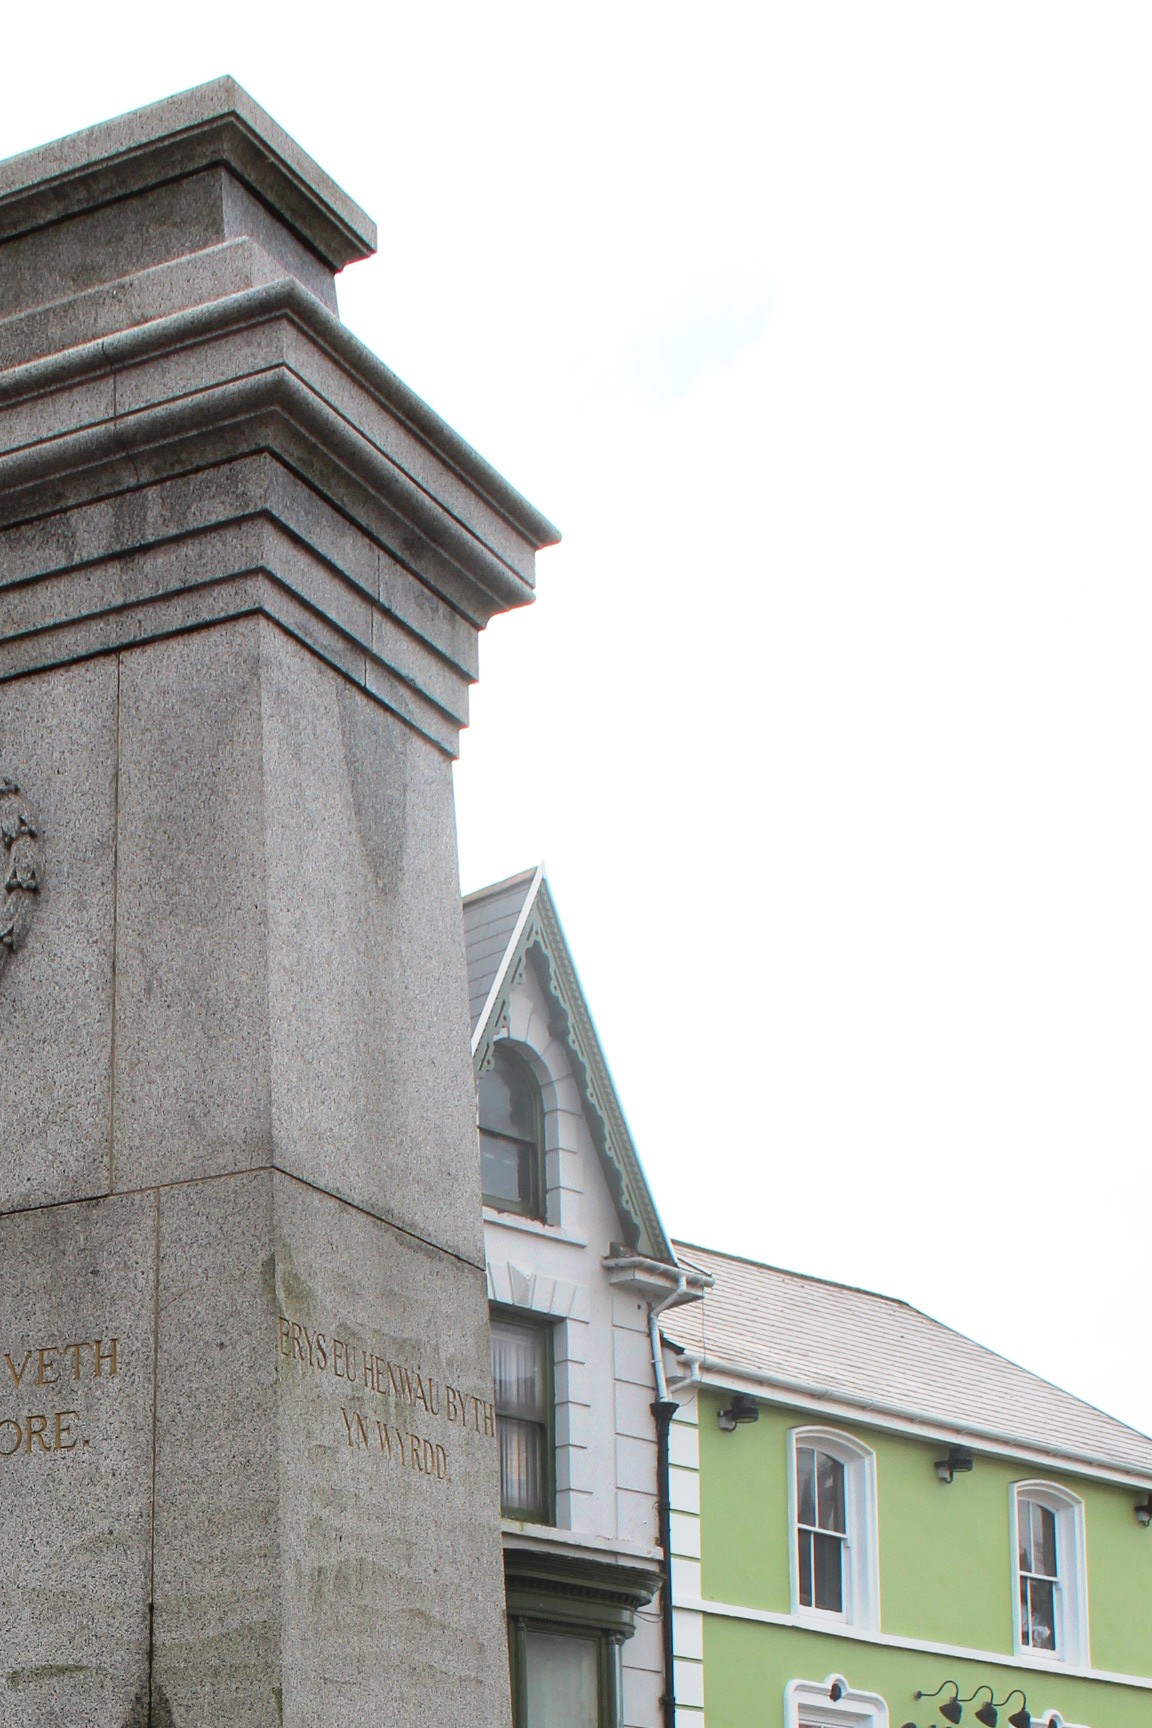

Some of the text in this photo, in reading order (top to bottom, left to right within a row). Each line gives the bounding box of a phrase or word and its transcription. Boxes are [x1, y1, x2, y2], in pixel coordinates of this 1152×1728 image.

[278, 1316, 328, 1370] ERYS
[332, 1338, 357, 1382] EU
[340, 1406, 369, 1451] YN
